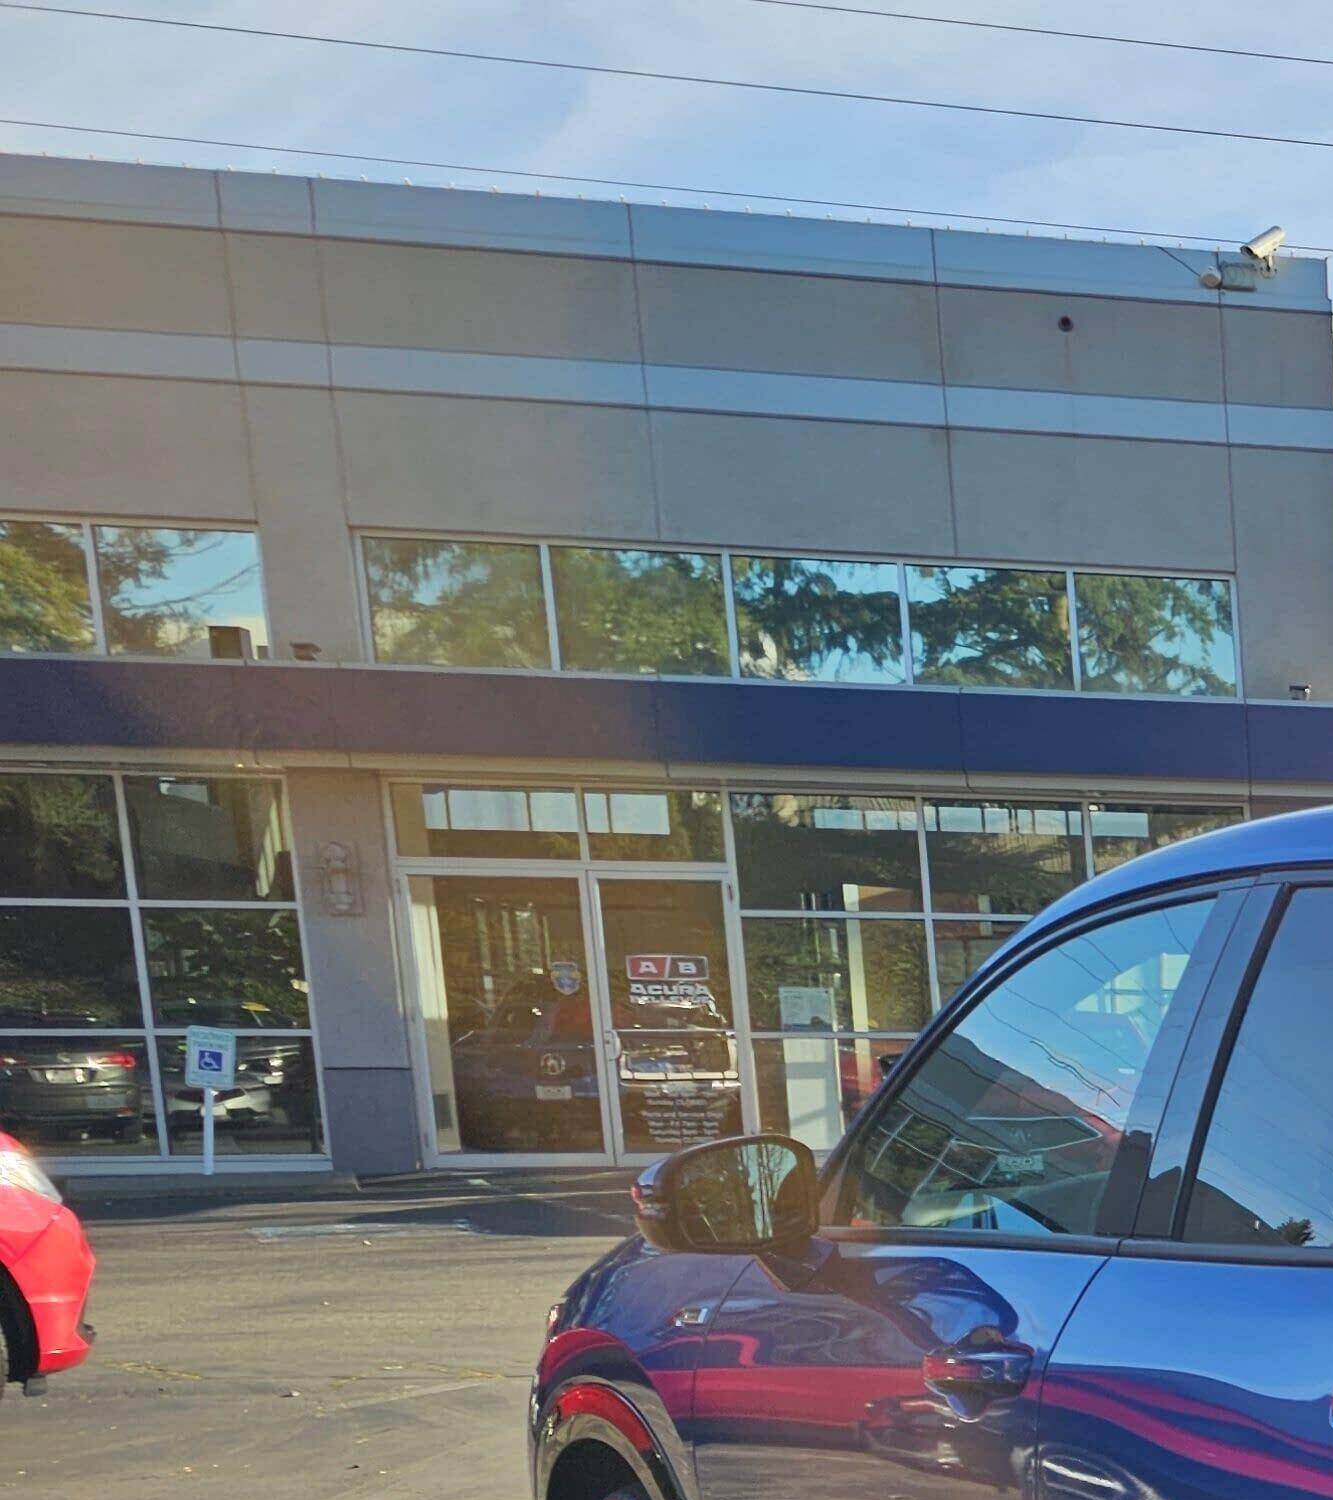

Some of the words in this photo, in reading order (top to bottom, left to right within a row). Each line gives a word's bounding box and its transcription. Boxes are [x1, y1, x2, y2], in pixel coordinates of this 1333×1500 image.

[638, 961, 658, 974] A
[678, 962, 697, 974] B
[629, 983, 710, 995] ACURA
